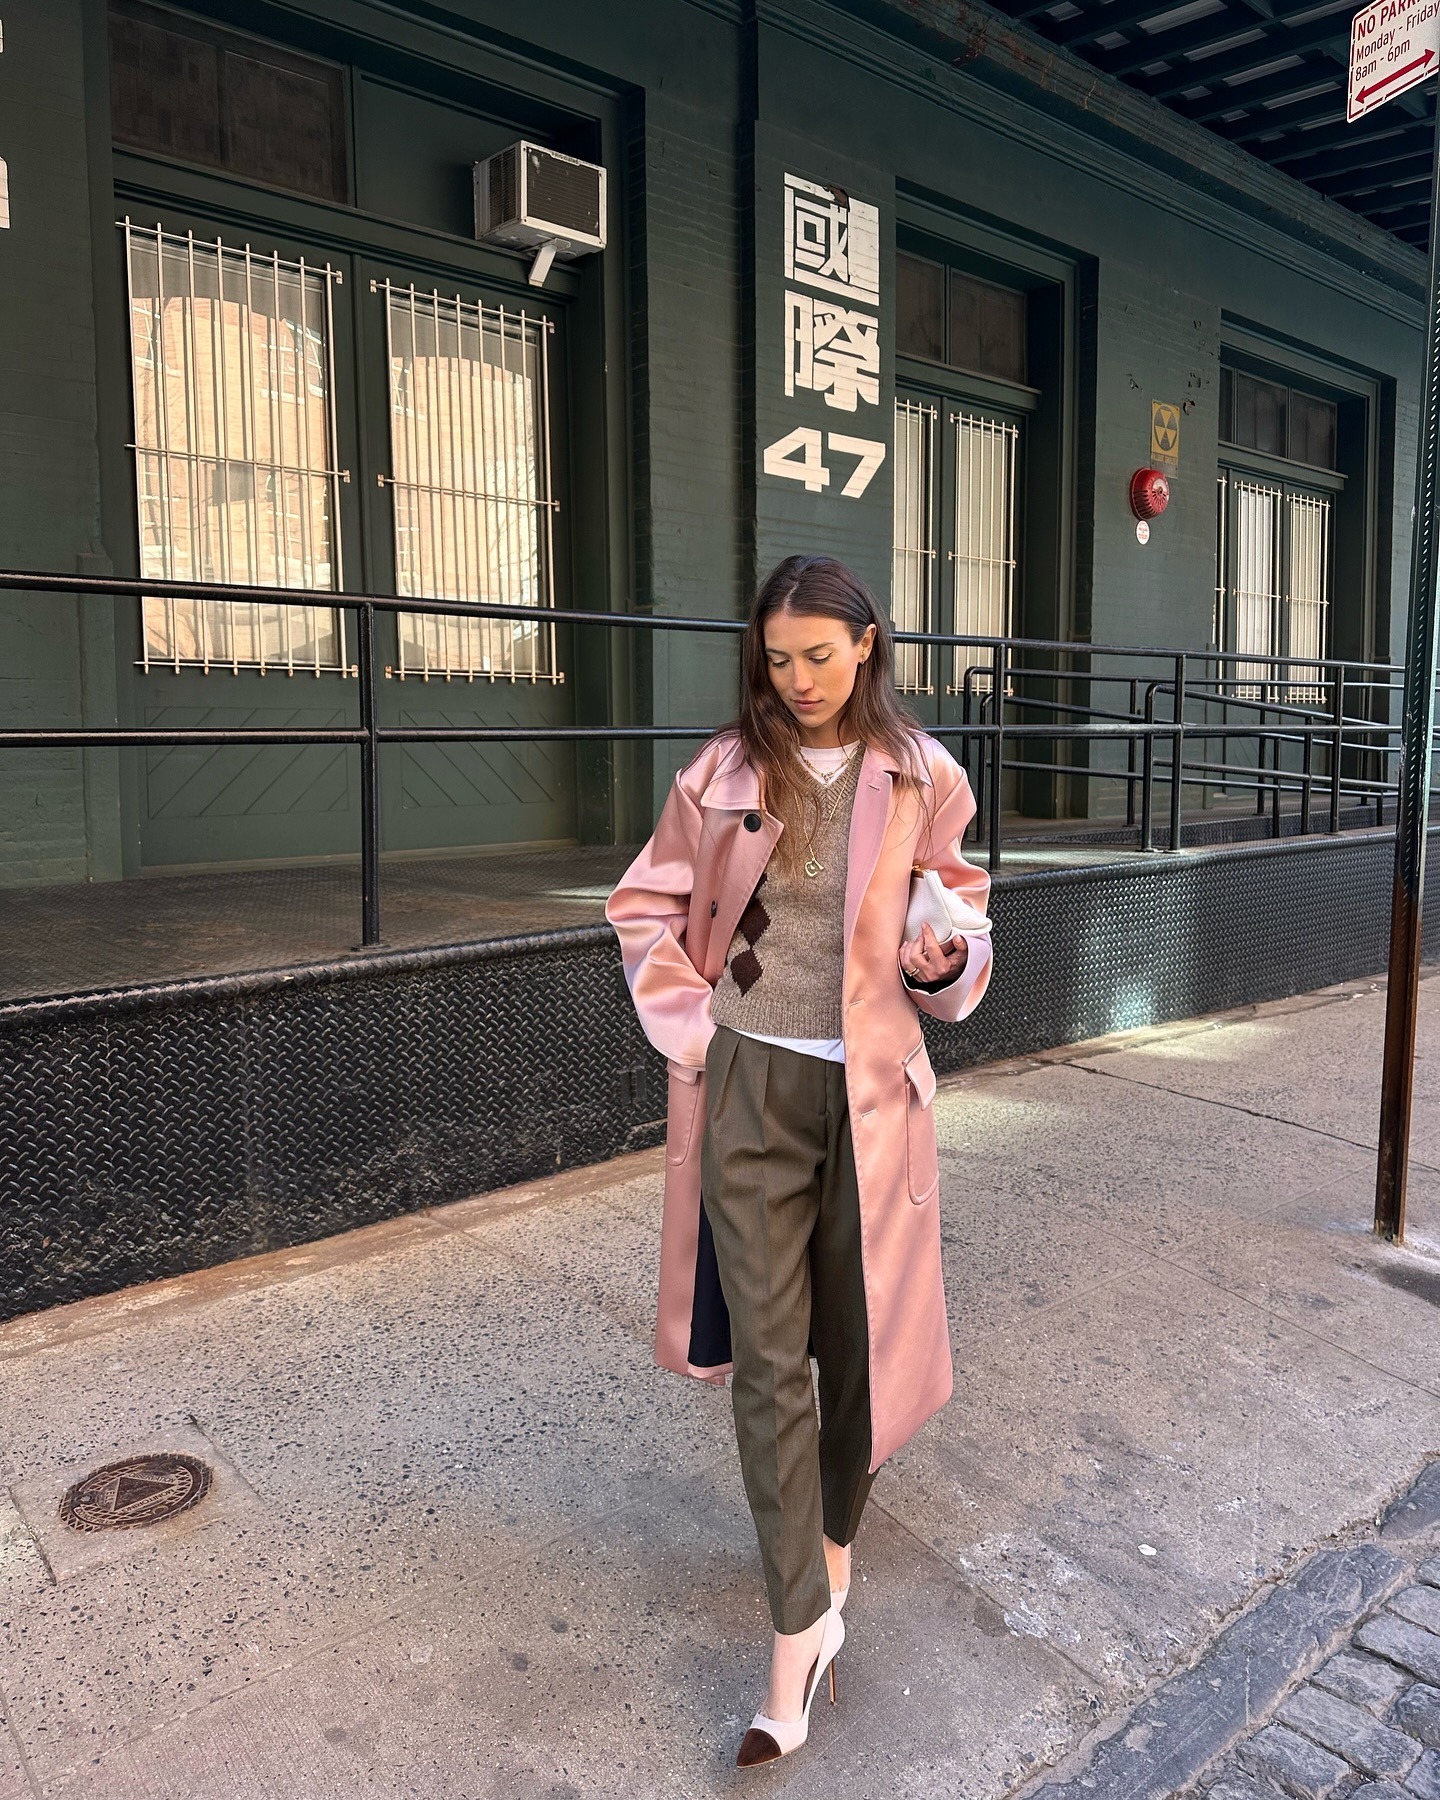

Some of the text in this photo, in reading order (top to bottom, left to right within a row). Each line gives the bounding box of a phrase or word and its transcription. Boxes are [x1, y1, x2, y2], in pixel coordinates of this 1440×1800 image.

[1356, 28, 1396, 63] Monday
[1406, 0, 1440, 31] Friday
[1357, 0, 1420, 41] NO PAR
[1355, 60, 1377, 82] 8am
[1387, 39, 1411, 63] 6pm
[784, 172, 880, 412] 國際
[763, 426, 886, 498] 47
[121, 1488, 176, 1513] MONITORING
